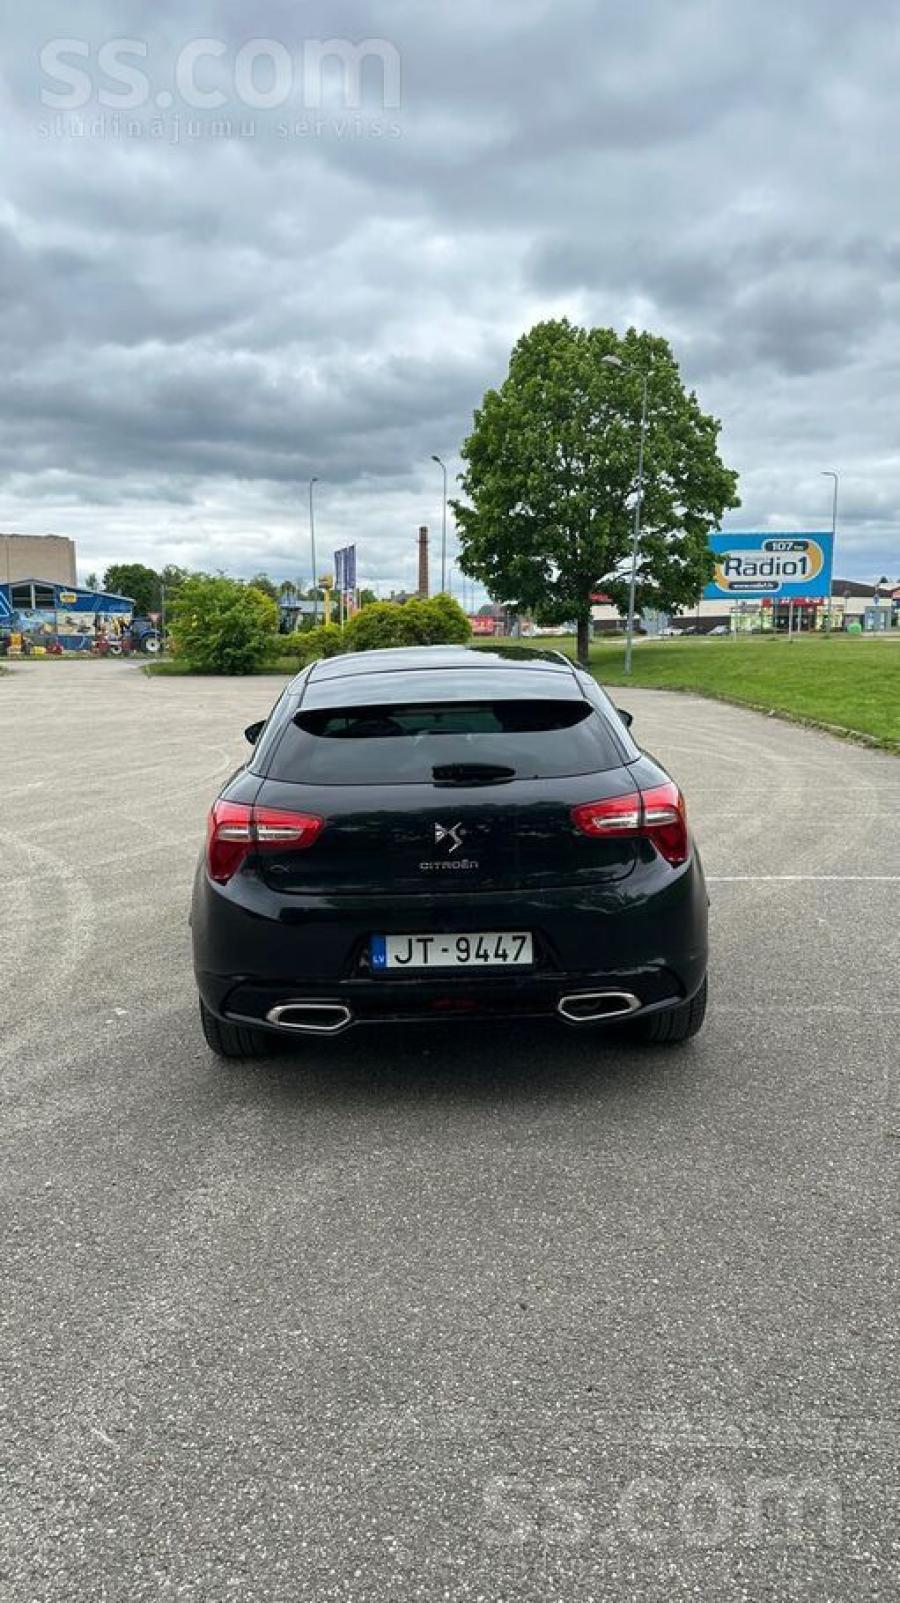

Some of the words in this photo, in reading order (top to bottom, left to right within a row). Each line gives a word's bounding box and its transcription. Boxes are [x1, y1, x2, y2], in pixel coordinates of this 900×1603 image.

[772, 541, 793, 551] 107
[725, 556, 807, 576] Radio1
[372, 955, 385, 965] LV
